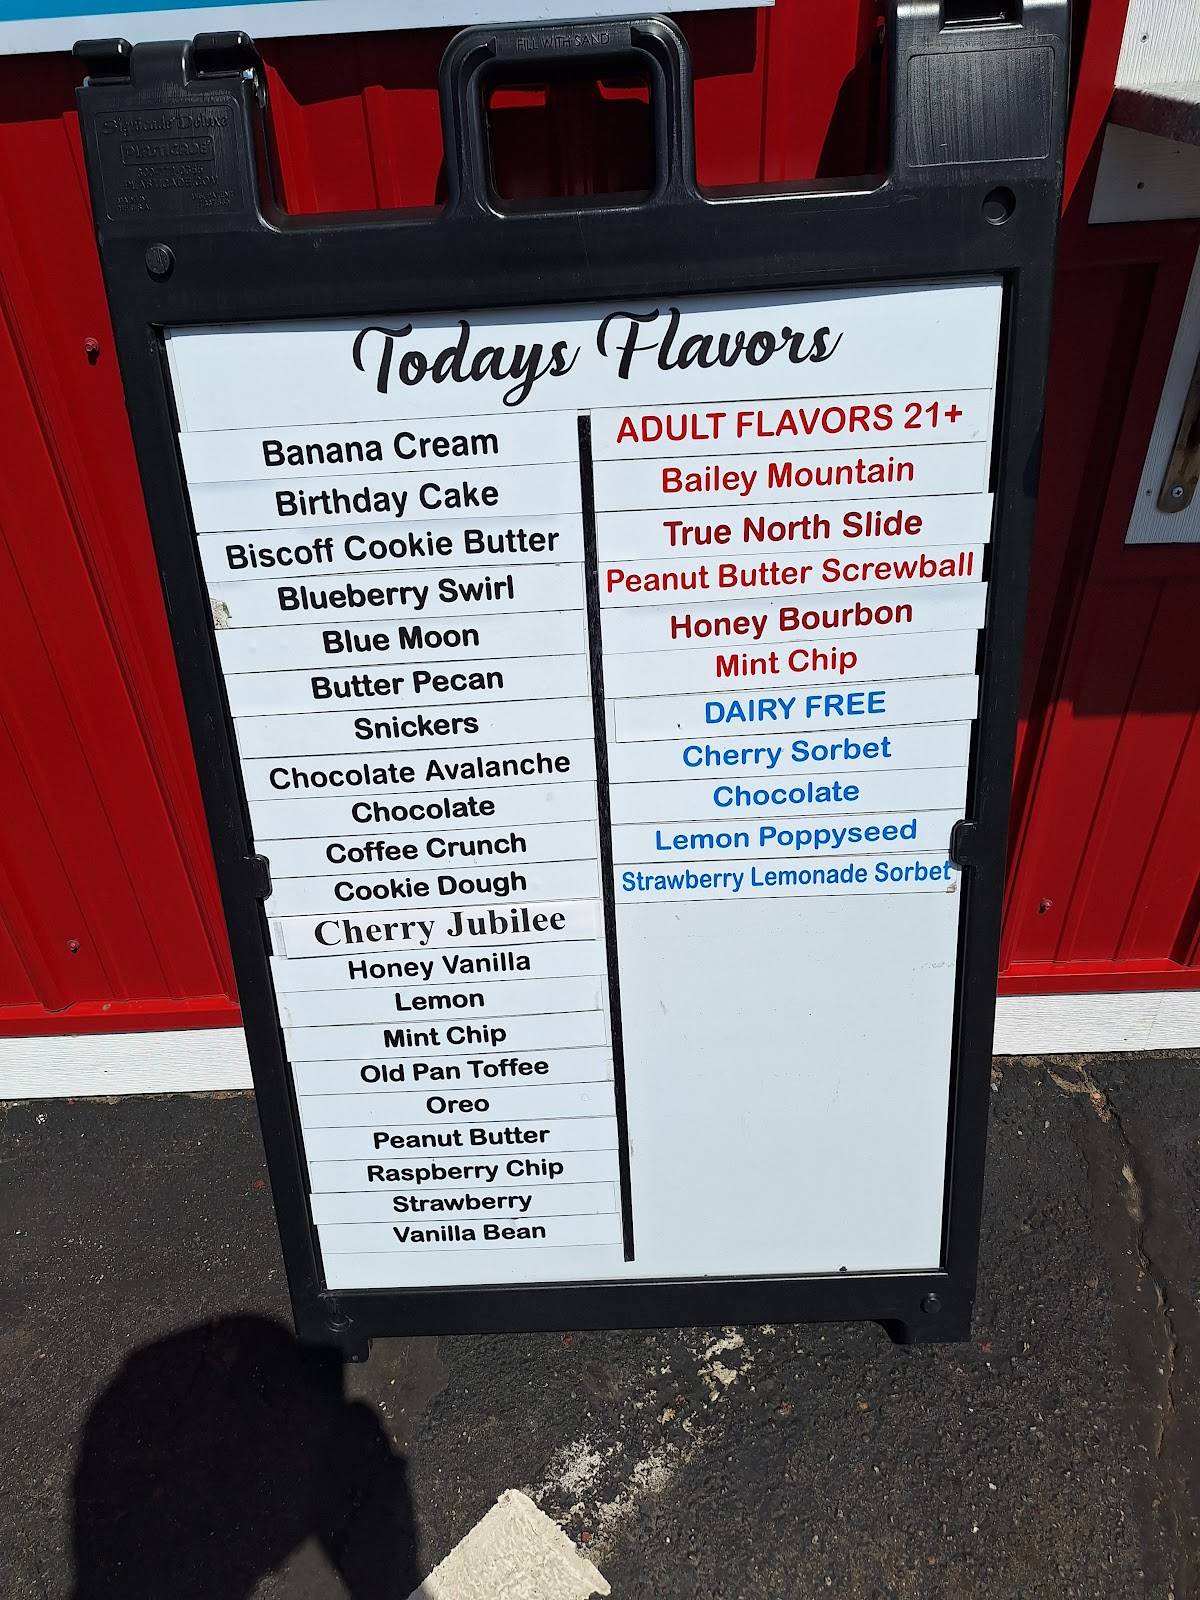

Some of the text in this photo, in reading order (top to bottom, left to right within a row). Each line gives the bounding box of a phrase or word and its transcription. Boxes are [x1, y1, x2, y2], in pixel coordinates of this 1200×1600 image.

[516, 32, 610, 51] FILL WITH SAND
[352, 307, 844, 406] Todays Flavors
[616, 401, 963, 444] ADULT FLAVORS 21+
[262, 431, 499, 467] Banana Cream
[662, 456, 914, 497] Bailey Mountain
[275, 481, 499, 519] Birthday Cake
[662, 509, 923, 547] True North Slide
[225, 528, 560, 570] Biscoff Cookie Butter
[605, 551, 974, 593] Peanut Butter Screwball
[277, 574, 515, 611] Blueberry Swirl
[670, 601, 913, 641] Honey Bourbon
[322, 625, 480, 654] Blue Moon
[716, 646, 858, 678] Mint Chip
[310, 670, 504, 700] Butter Pecan
[705, 690, 886, 724] DAIRY FREE
[354, 714, 479, 741] Snickers
[682, 736, 892, 770] Cherry Sorbet
[269, 752, 571, 790] Chocolate Avalanche
[351, 796, 496, 824] Chocolate
[712, 780, 861, 809] Chocolate
[325, 832, 527, 864] Coffee Crunch
[655, 818, 918, 851] Lemon Poppyseed
[334, 870, 527, 902] Cookie Dough
[622, 860, 952, 893] Strawberry Lemonade Sorbet
[313, 908, 567, 947] Cherry Jubilee
[348, 951, 531, 981] Honey Vanilla
[394, 992, 485, 1012] Lemon
[383, 1024, 507, 1048] Mint Chip
[360, 1057, 549, 1084] Old Pan Toffee
[426, 1096, 490, 1115] Oreo
[373, 1126, 551, 1150] Peanut Butter
[366, 1158, 564, 1185] Raspberry Chip
[392, 1193, 533, 1213] Strawberry
[392, 1223, 546, 1243] Vanilla Bean
